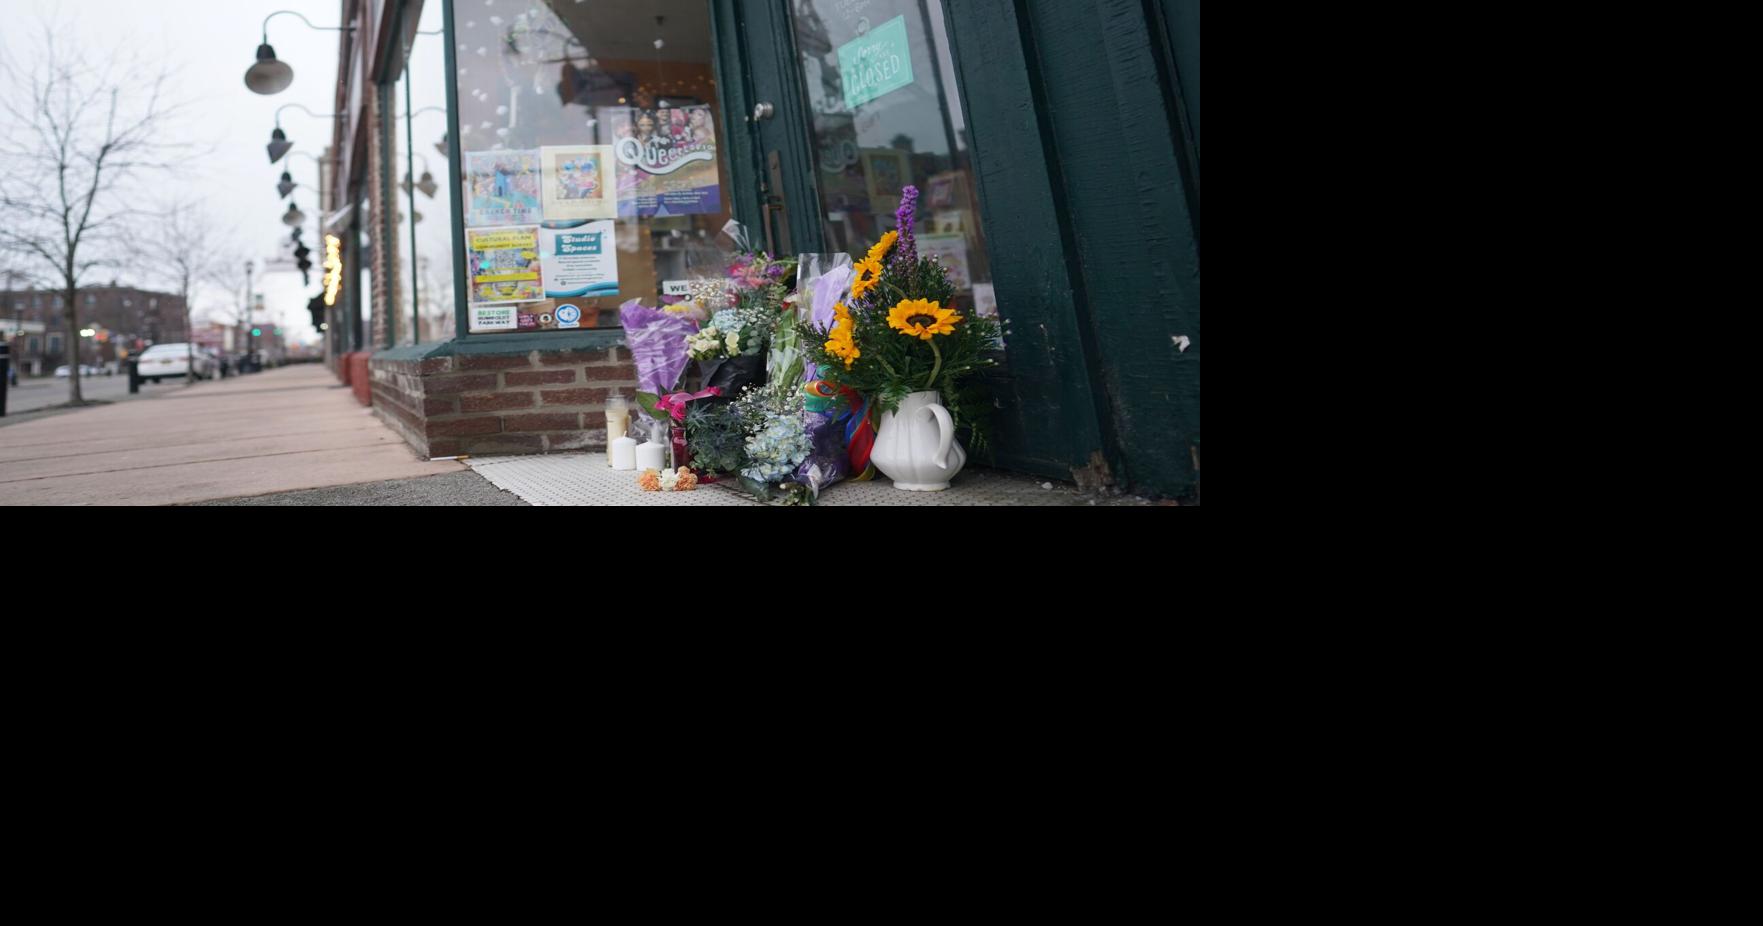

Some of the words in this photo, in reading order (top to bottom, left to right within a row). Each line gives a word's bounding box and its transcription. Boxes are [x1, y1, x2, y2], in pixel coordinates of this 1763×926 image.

[851, 54, 900, 95] CLOSED
[561, 235, 596, 243] Studio
[561, 244, 597, 253] Spaces
